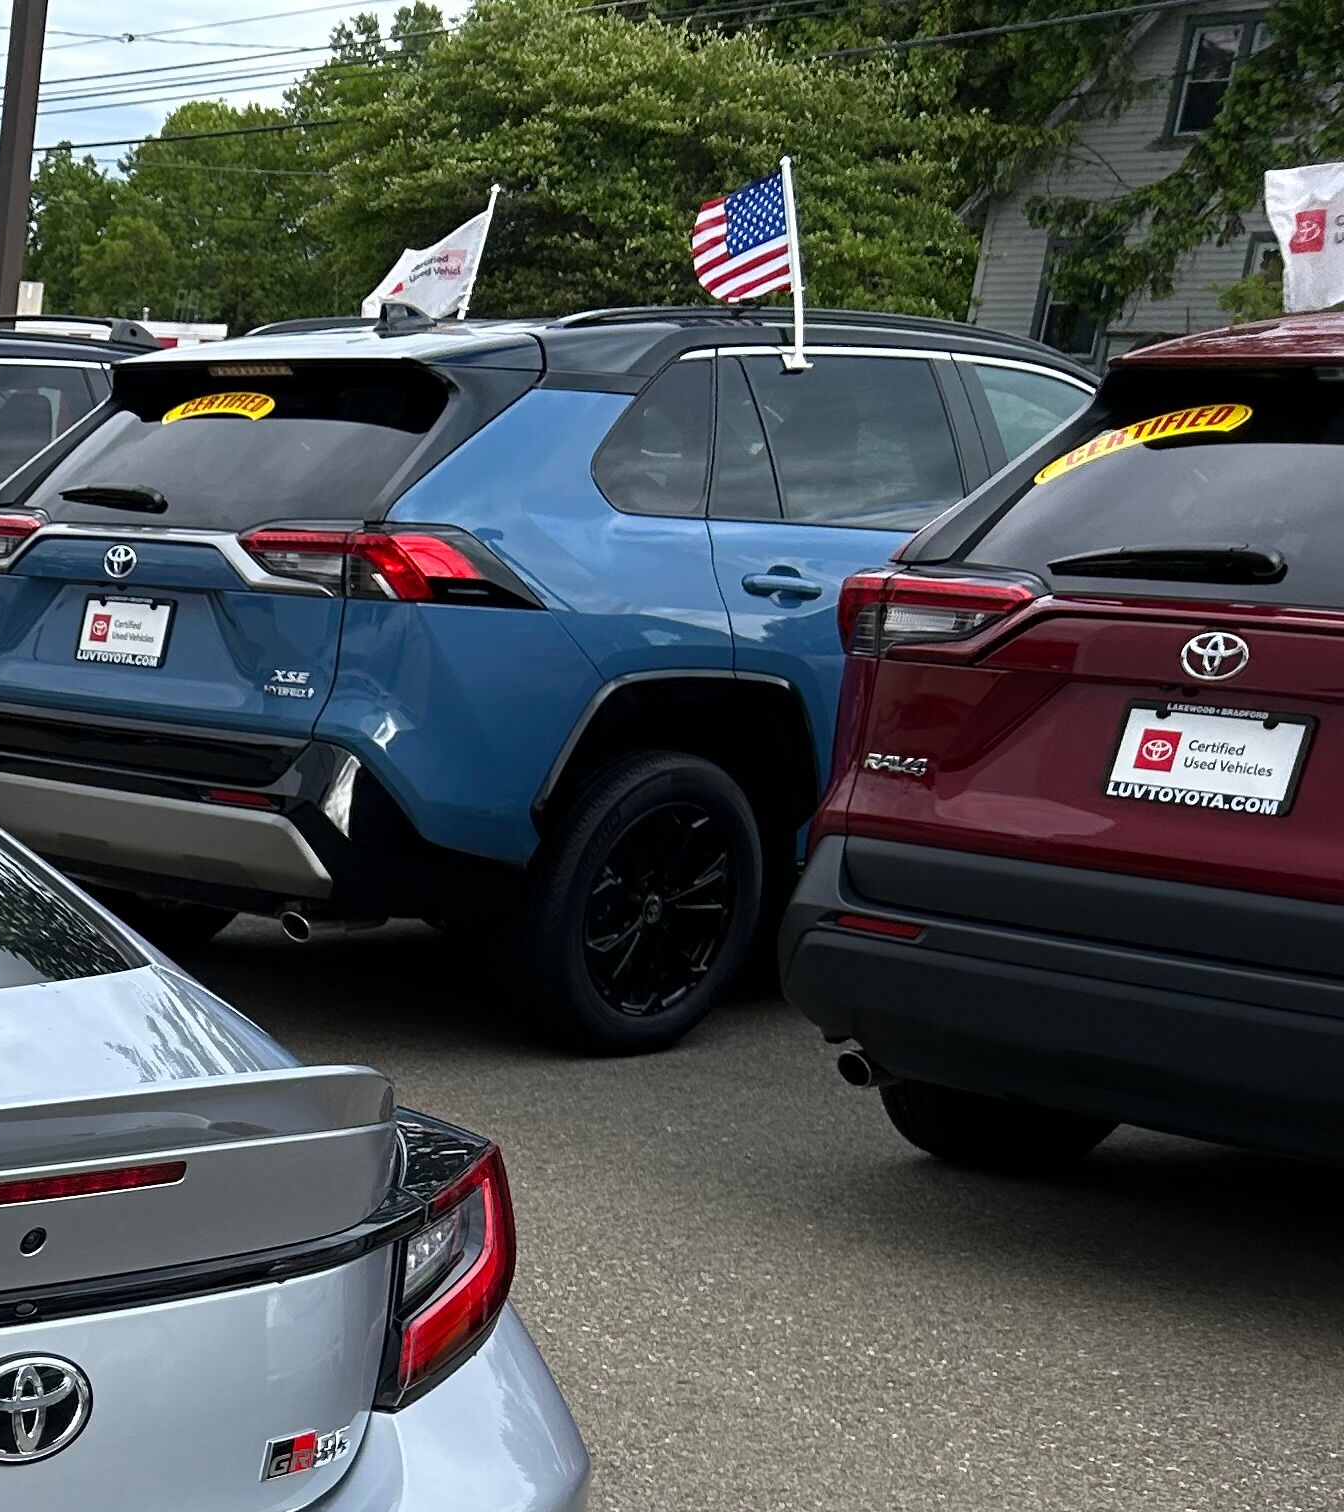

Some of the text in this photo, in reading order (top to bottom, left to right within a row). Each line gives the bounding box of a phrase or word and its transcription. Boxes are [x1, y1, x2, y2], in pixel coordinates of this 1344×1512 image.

[180, 394, 270, 415] CERTIFIED
[1065, 405, 1235, 466] CERTIFIED
[114, 619, 142, 630] Certified
[76, 649, 159, 668] LUVTOYOTA.COM
[270, 669, 311, 685] XSE
[1166, 702, 1269, 720] LAKEWOOD BRADFORD
[1188, 739, 1247, 757] Certified
[863, 751, 929, 777] RAV4
[1183, 756, 1274, 778] Used Vehicles
[1105, 781, 1280, 816] LUVTOYOTA.COM
